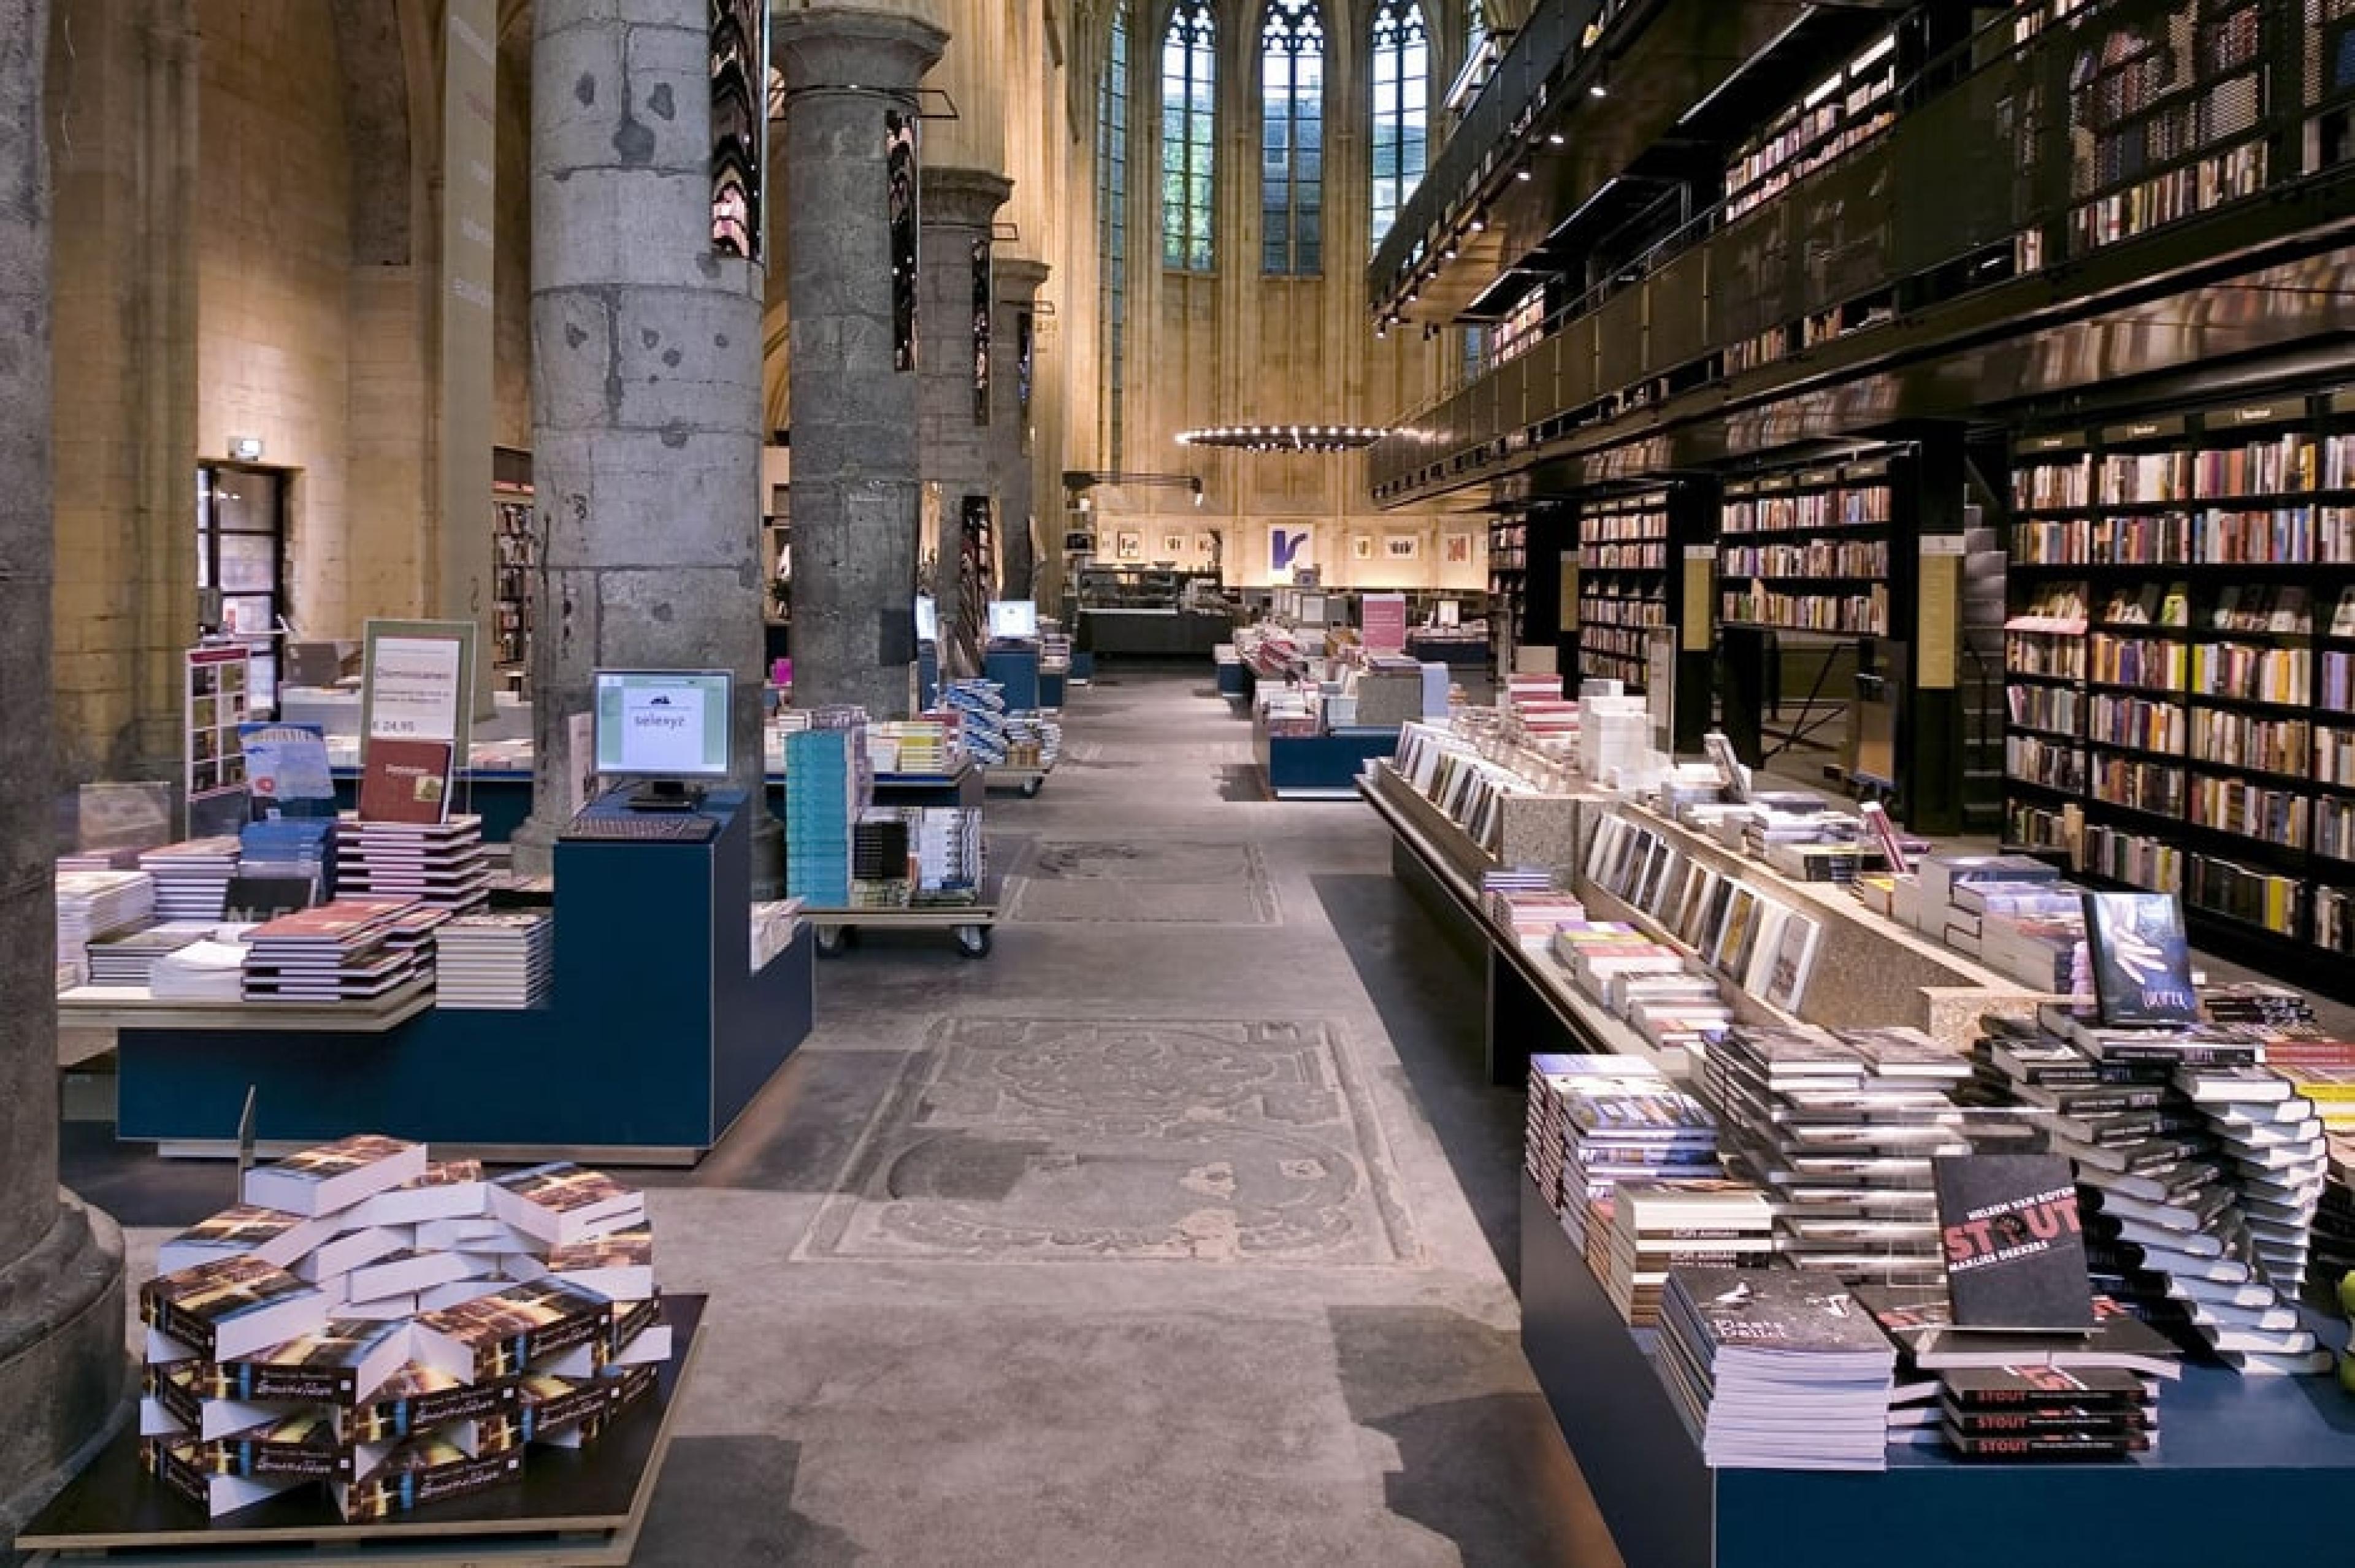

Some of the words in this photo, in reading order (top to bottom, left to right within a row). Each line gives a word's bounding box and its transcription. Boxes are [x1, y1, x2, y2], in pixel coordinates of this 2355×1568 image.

[1975, 1390, 2028, 1403] STOUT
[1976, 1417, 2027, 1429] STOUT
[1977, 1440, 2028, 1453] STOUT
